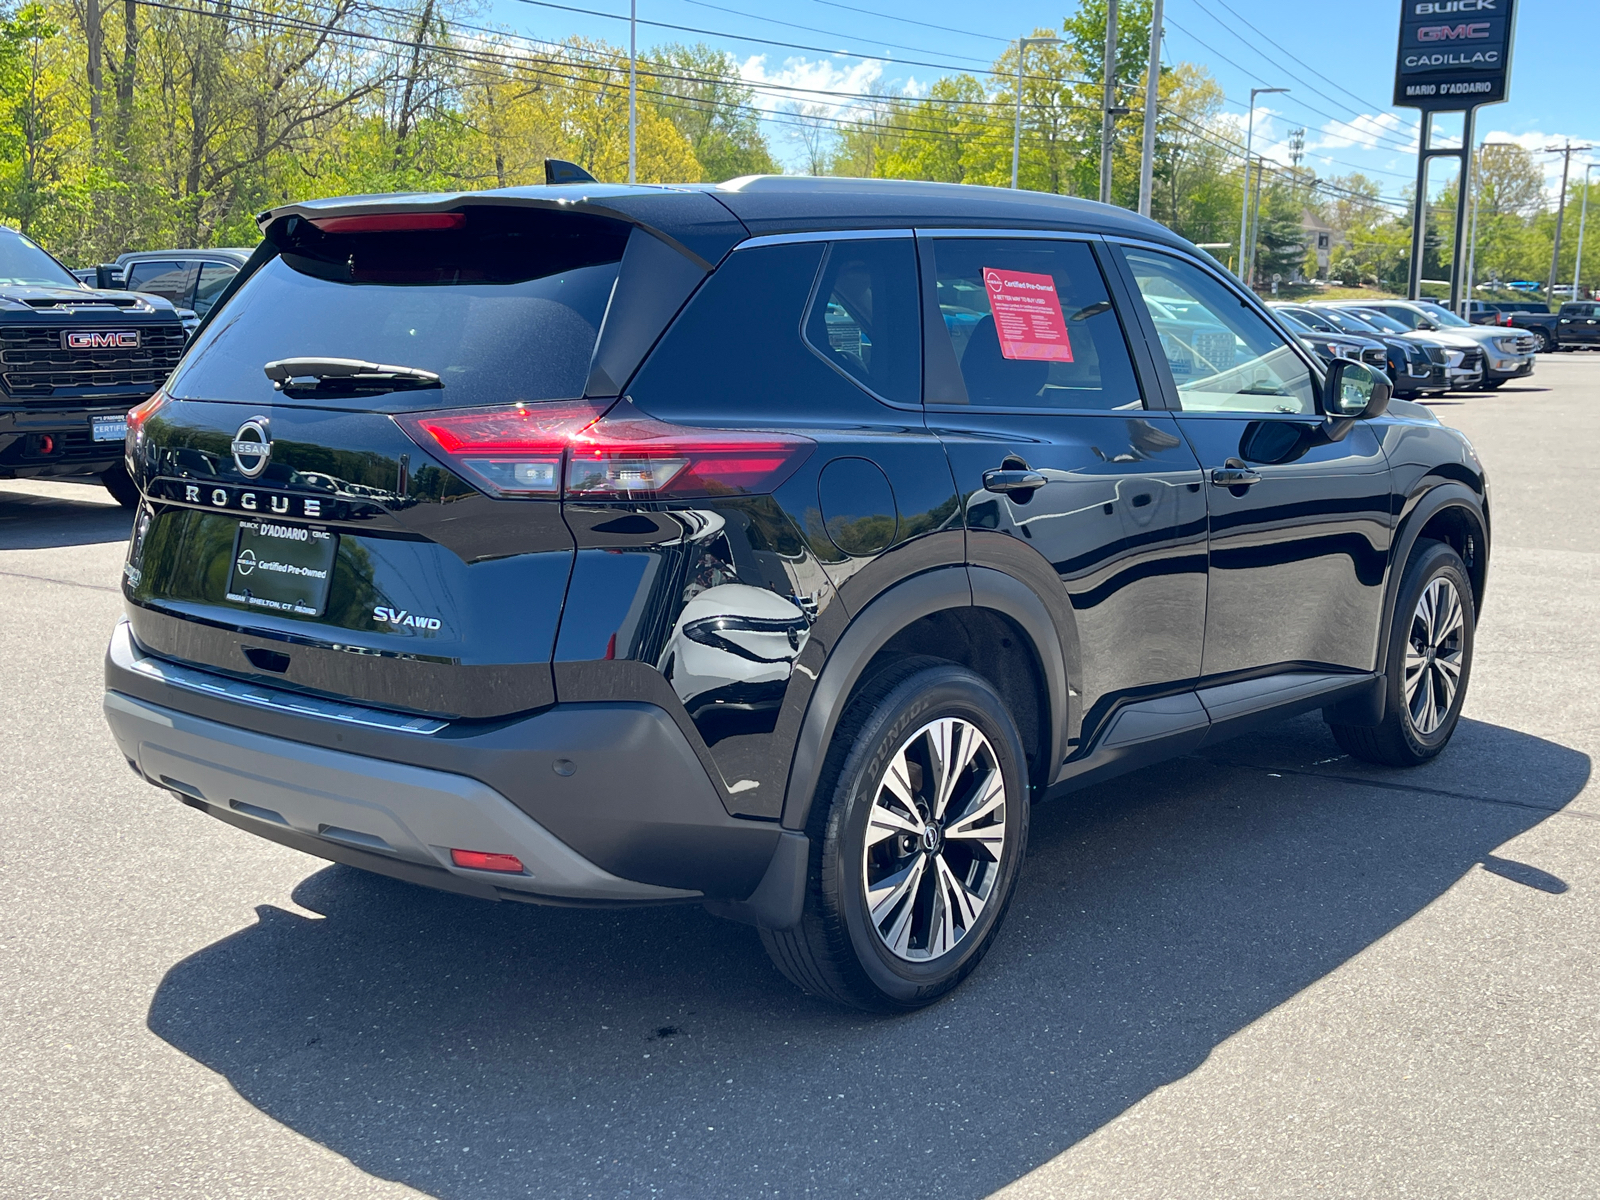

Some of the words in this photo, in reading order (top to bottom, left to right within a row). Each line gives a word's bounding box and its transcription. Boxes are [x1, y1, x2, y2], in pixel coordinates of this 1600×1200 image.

[1415, 0, 1496, 14] BUICK
[1417, 22, 1490, 42] GMC
[1405, 51, 1498, 67] CADILLAC
[1406, 84, 1436, 96] MARIO
[1440, 82, 1491, 95] D'ADDARIO
[1004, 280, 1026, 289] Certified
[1026, 282, 1054, 292] Pre-Owned
[68, 333, 137, 347] GMC
[93, 424, 128, 433] CERTIFIE
[232, 441, 270, 457] NISSAN
[185, 485, 322, 517] ROGUE
[239, 521, 259, 529] BUICK
[260, 523, 308, 541] D'ADDARIO
[312, 531, 331, 539] GMC
[258, 560, 287, 573] Certified
[288, 565, 327, 579] Pre-Owned
[248, 597, 281, 609] SHELTON,
